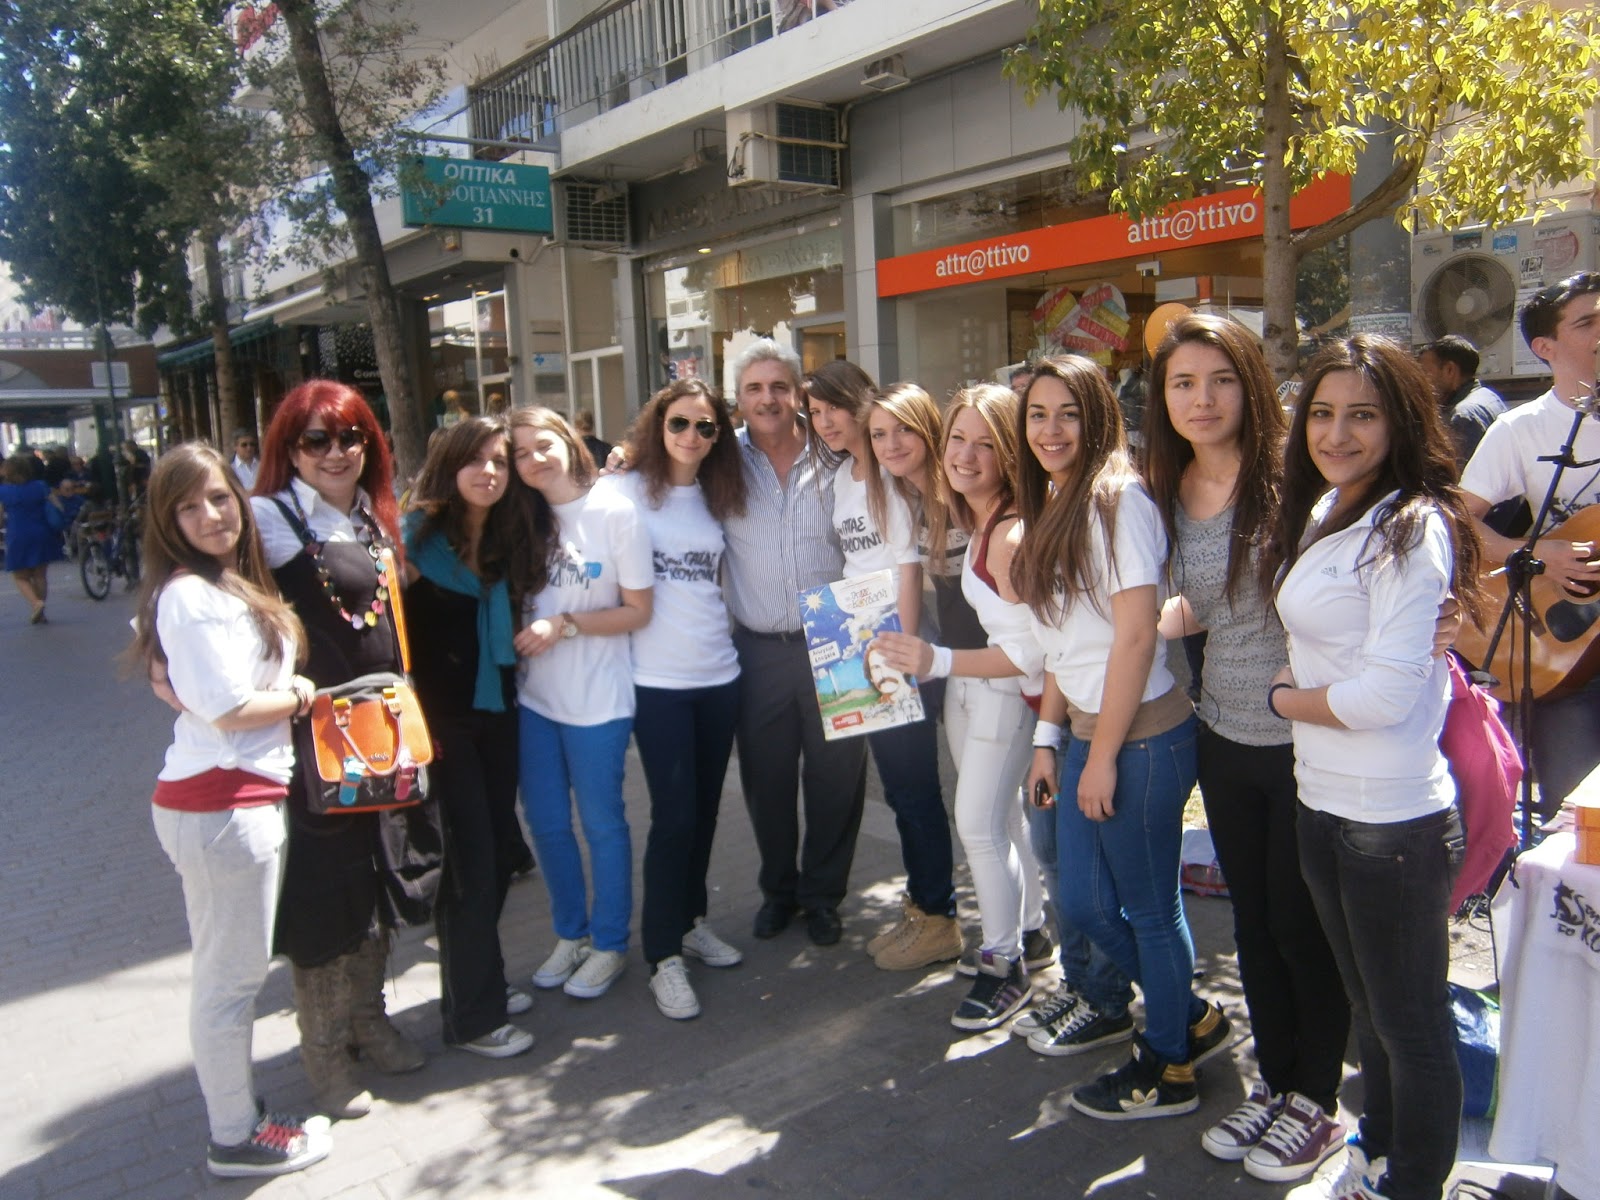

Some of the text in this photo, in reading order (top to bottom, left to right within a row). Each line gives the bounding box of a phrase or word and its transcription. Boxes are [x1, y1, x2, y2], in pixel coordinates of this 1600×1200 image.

[444, 164, 517, 184] ΟΠΤΙΚΑ
[412, 182, 546, 208] ΡΟΓΙΑΝΝΗΣ
[472, 206, 494, 224] 31
[1127, 201, 1257, 244] attr@ttivo
[935, 242, 1030, 277] attr@ttivo
